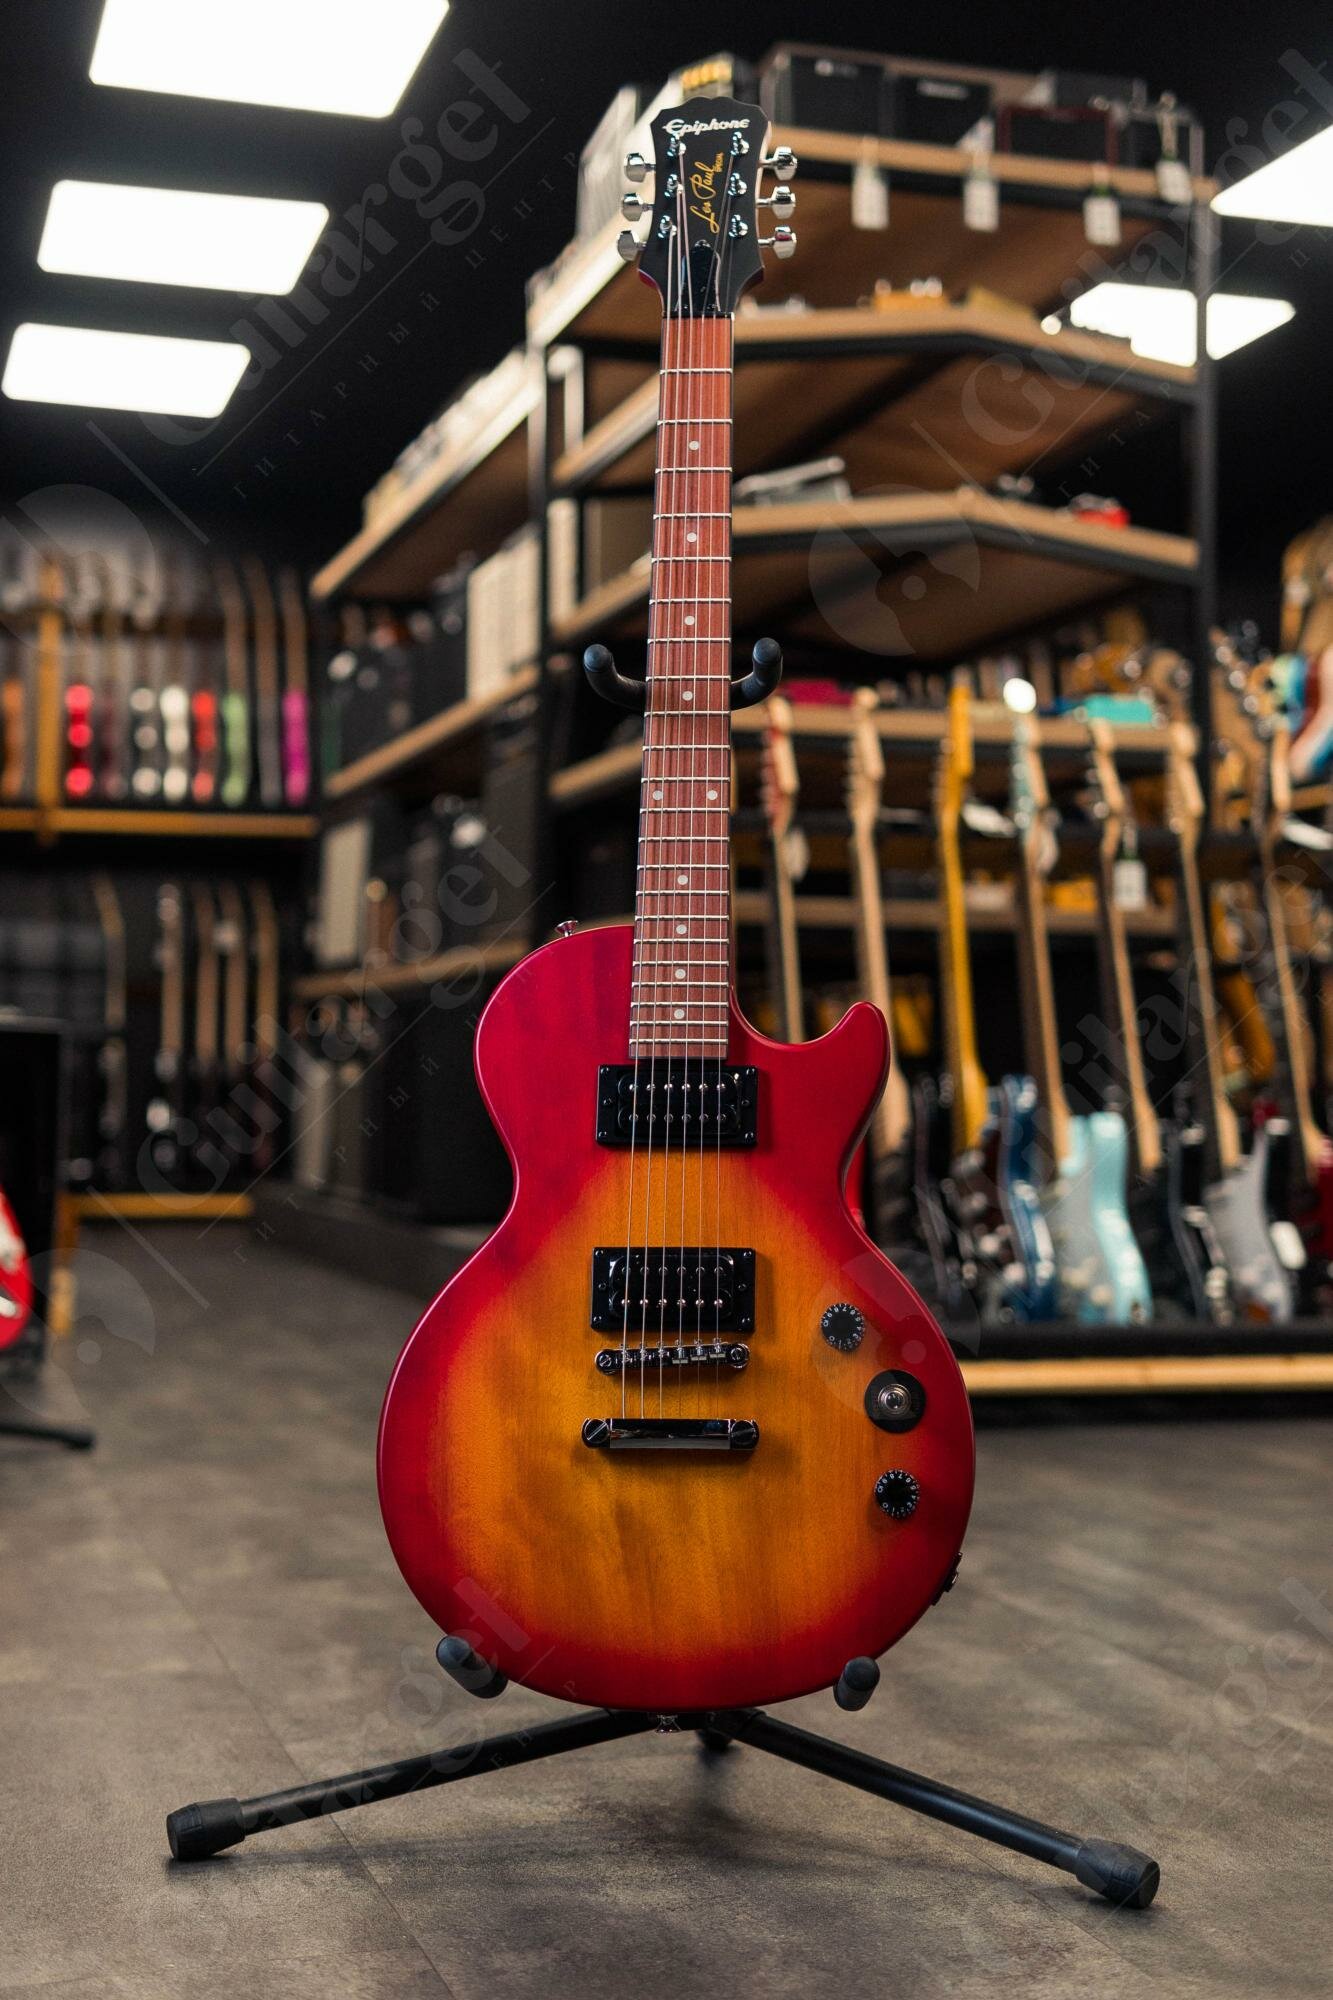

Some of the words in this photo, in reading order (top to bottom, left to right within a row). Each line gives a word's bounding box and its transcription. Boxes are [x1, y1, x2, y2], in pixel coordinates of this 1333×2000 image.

[662, 118, 750, 137] Epiphone
[690, 161, 715, 200] Paul
[690, 202, 720, 234] Les
